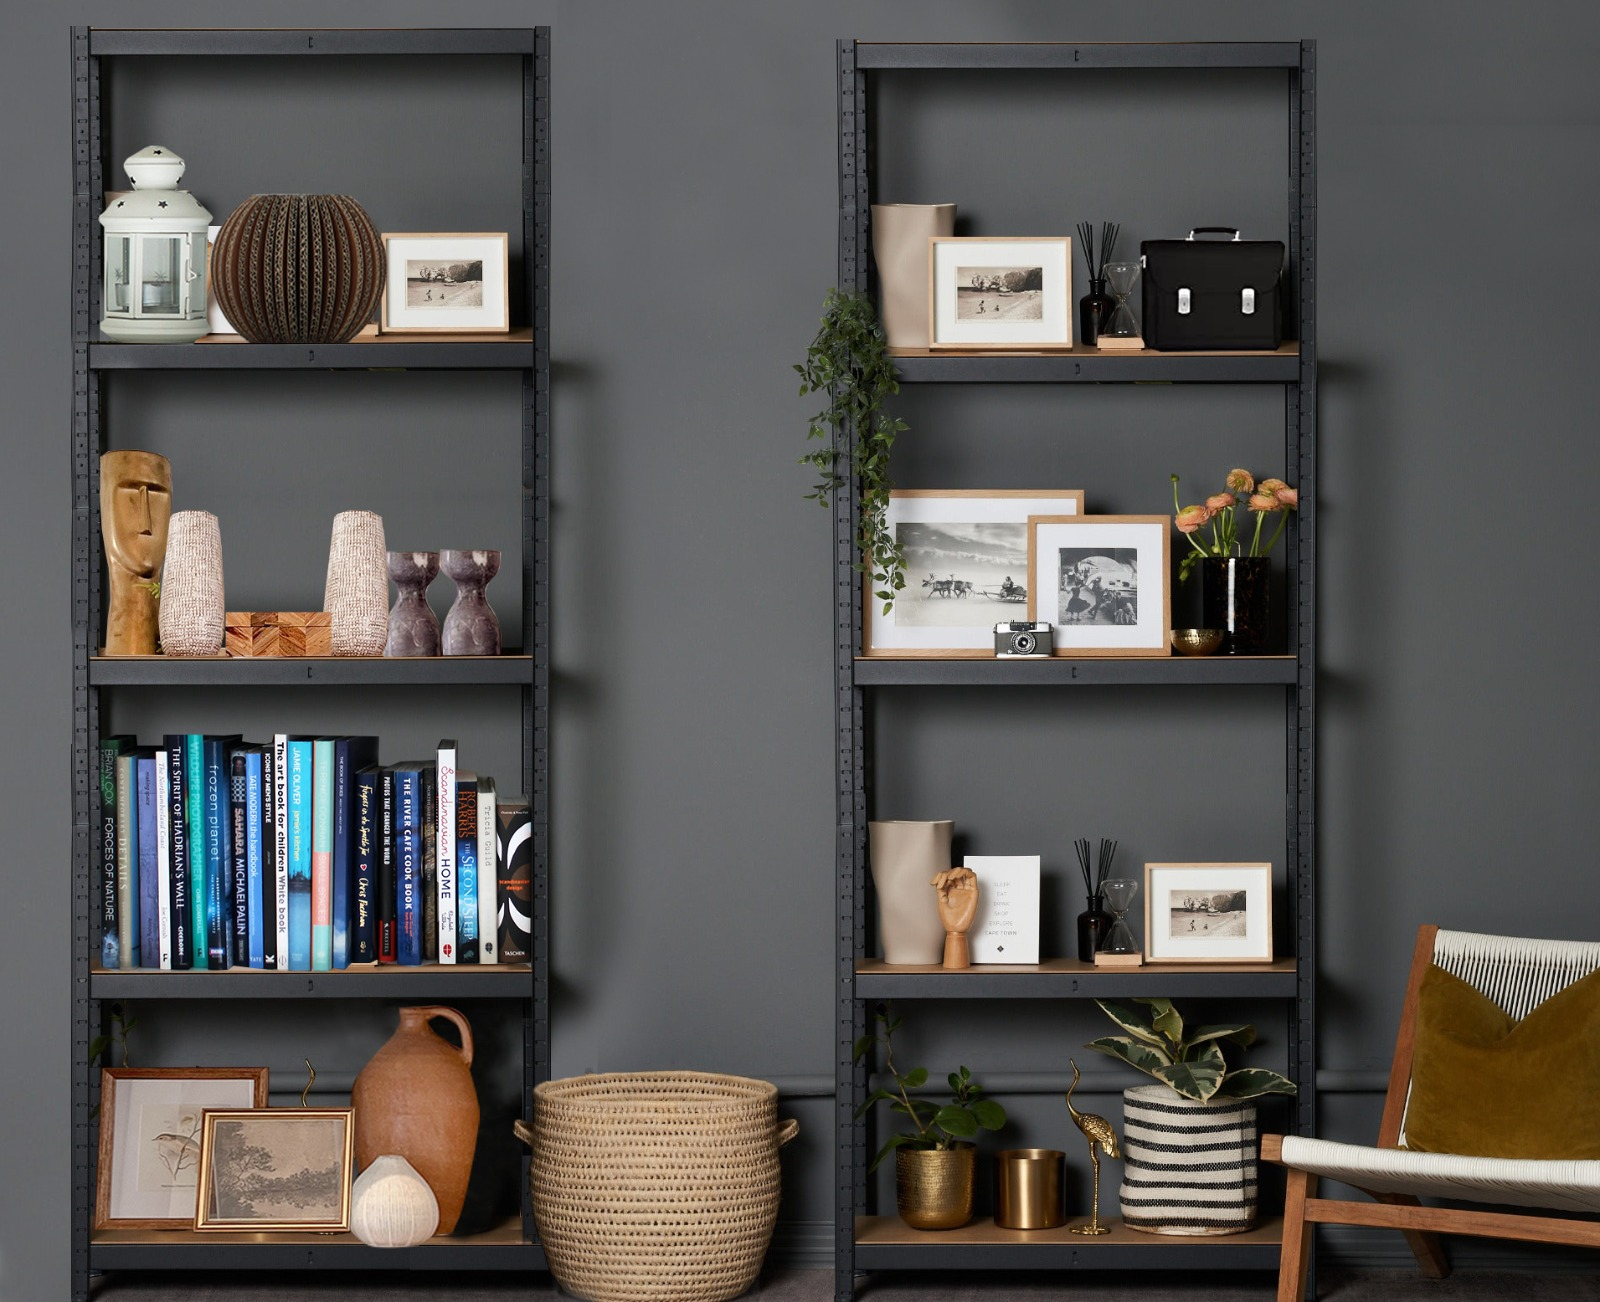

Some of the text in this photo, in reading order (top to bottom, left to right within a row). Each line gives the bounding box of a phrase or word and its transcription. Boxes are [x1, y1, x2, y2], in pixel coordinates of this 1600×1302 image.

[105, 749, 113, 805] BRIAN COX
[265, 774, 271, 782] OF
[173, 746, 184, 910] THE SPIRIT OF HADRIAN'S WALL
[190, 742, 202, 881] WILDLIFE PHOTOGRAPHER
[209, 765, 220, 860] frozen planet
[235, 808, 244, 855] SAHARA
[441, 766, 454, 899] Scandinavian HOME
[458, 791, 467, 838] HARRIS
[467, 791, 476, 838] ROBERT
[105, 818, 114, 921] FORCES OF NATURE
[236, 858, 245, 904] MICHAEL
[250, 840, 258, 877] handbook
[318, 855, 326, 884] SMALL
[462, 856, 475, 907] SECOND
[318, 887, 326, 922] SPACES
[359, 878, 369, 897] Chris
[237, 906, 246, 935] PALIN
[463, 908, 475, 940] SLEEP
